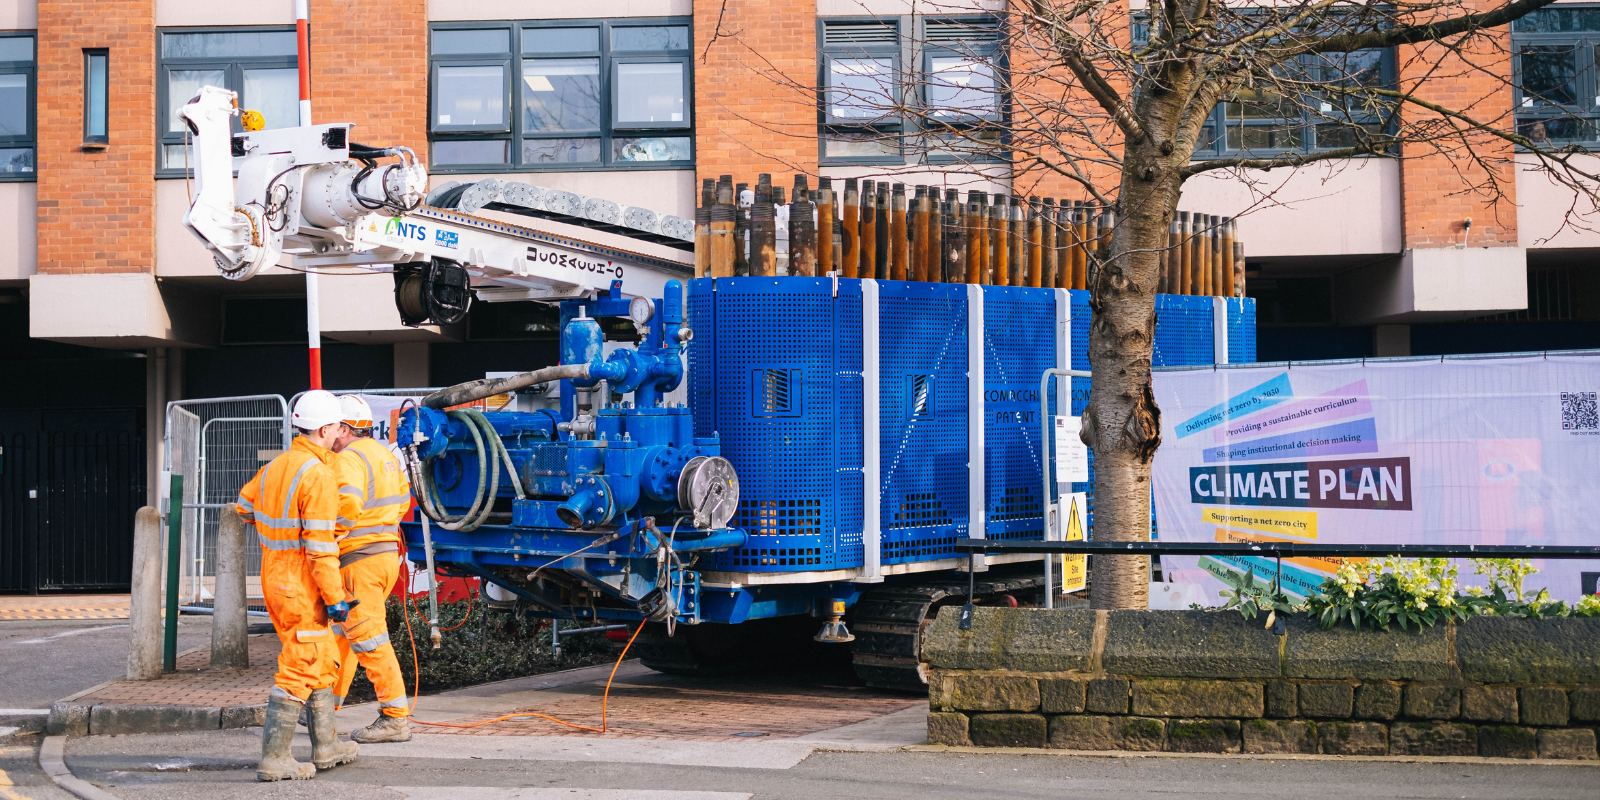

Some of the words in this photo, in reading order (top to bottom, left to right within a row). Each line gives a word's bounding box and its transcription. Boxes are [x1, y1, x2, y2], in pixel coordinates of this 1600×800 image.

[385, 217, 426, 241] ANTS
[539, 252, 624, 279] COMACCHIO
[984, 390, 1048, 402] COMACCHI
[996, 411, 1035, 423] PATENT
[1186, 412, 1222, 432] Delivering
[1223, 406, 1234, 417] net
[1235, 400, 1251, 412] zero
[1252, 396, 1262, 404] by
[1263, 387, 1280, 399] 2030
[1226, 423, 1262, 437] Providing
[1269, 408, 1312, 425] sustainable
[1313, 397, 1358, 414] curriculum
[1216, 448, 1246, 458] Shaping
[1247, 441, 1295, 454] institutional
[1296, 438, 1330, 449] decision
[1331, 434, 1361, 444] making
[1194, 470, 1310, 500] CLIMATE
[1318, 466, 1403, 502] PLAN
[1211, 512, 1252, 525] Supporting
[1293, 520, 1307, 530] city
[1221, 555, 1253, 568] nabling
